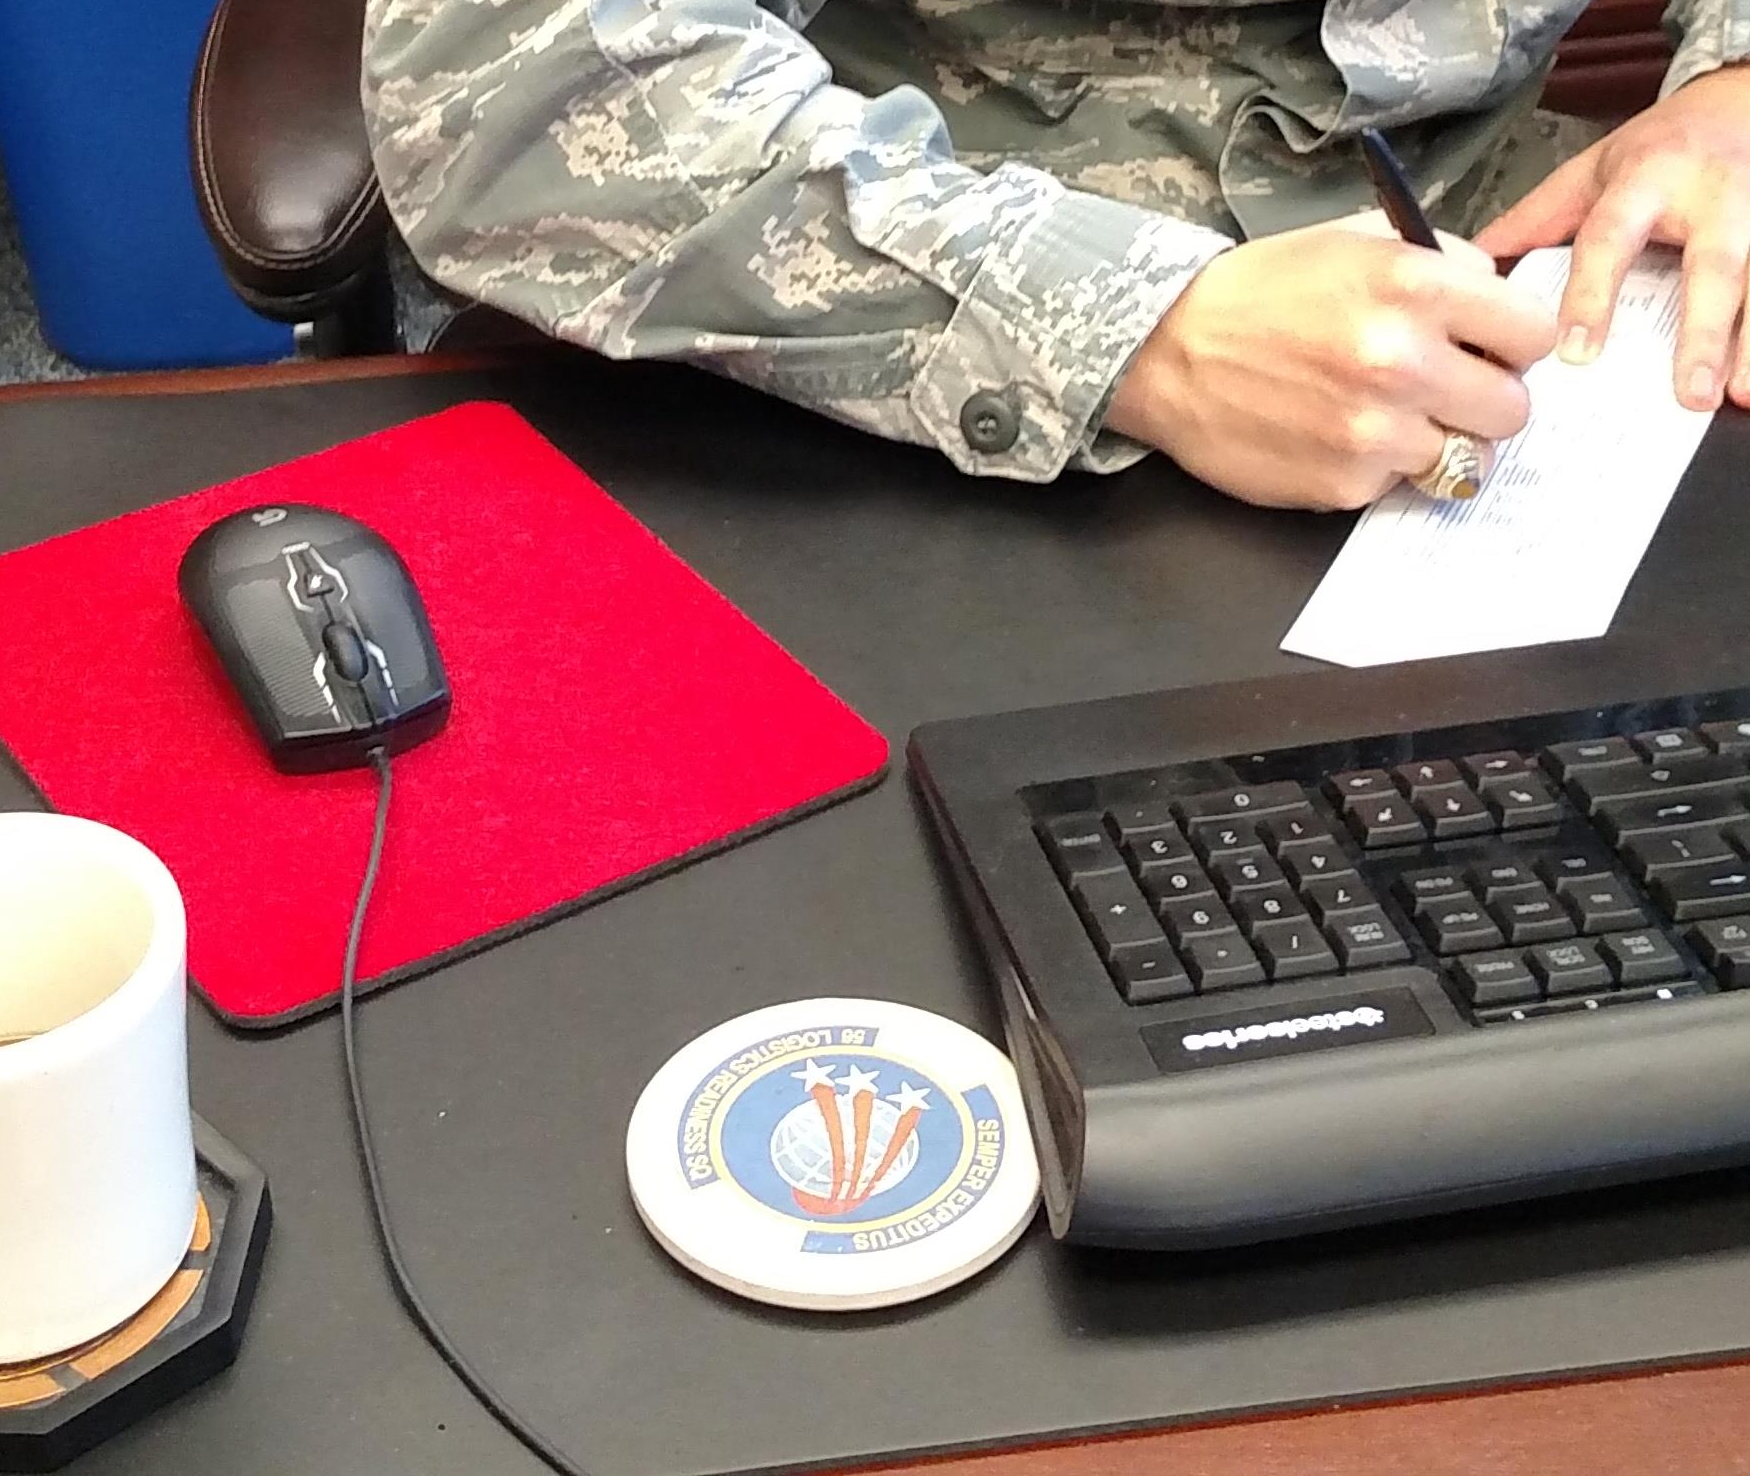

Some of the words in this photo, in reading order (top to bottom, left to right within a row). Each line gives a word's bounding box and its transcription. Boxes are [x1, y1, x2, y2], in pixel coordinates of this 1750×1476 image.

[1219, 831, 1237, 844] 2
[1151, 840, 1168, 853] 3
[1311, 855, 1326, 869] 4
[1171, 875, 1188, 889] 6
[1337, 889, 1351, 902] 7
[1263, 899, 1281, 913] 8
[1192, 910, 1210, 925] 9
[963, 1118, 1000, 1191] SEMPER
[853, 1187, 972, 1251] EXPEDITUS
